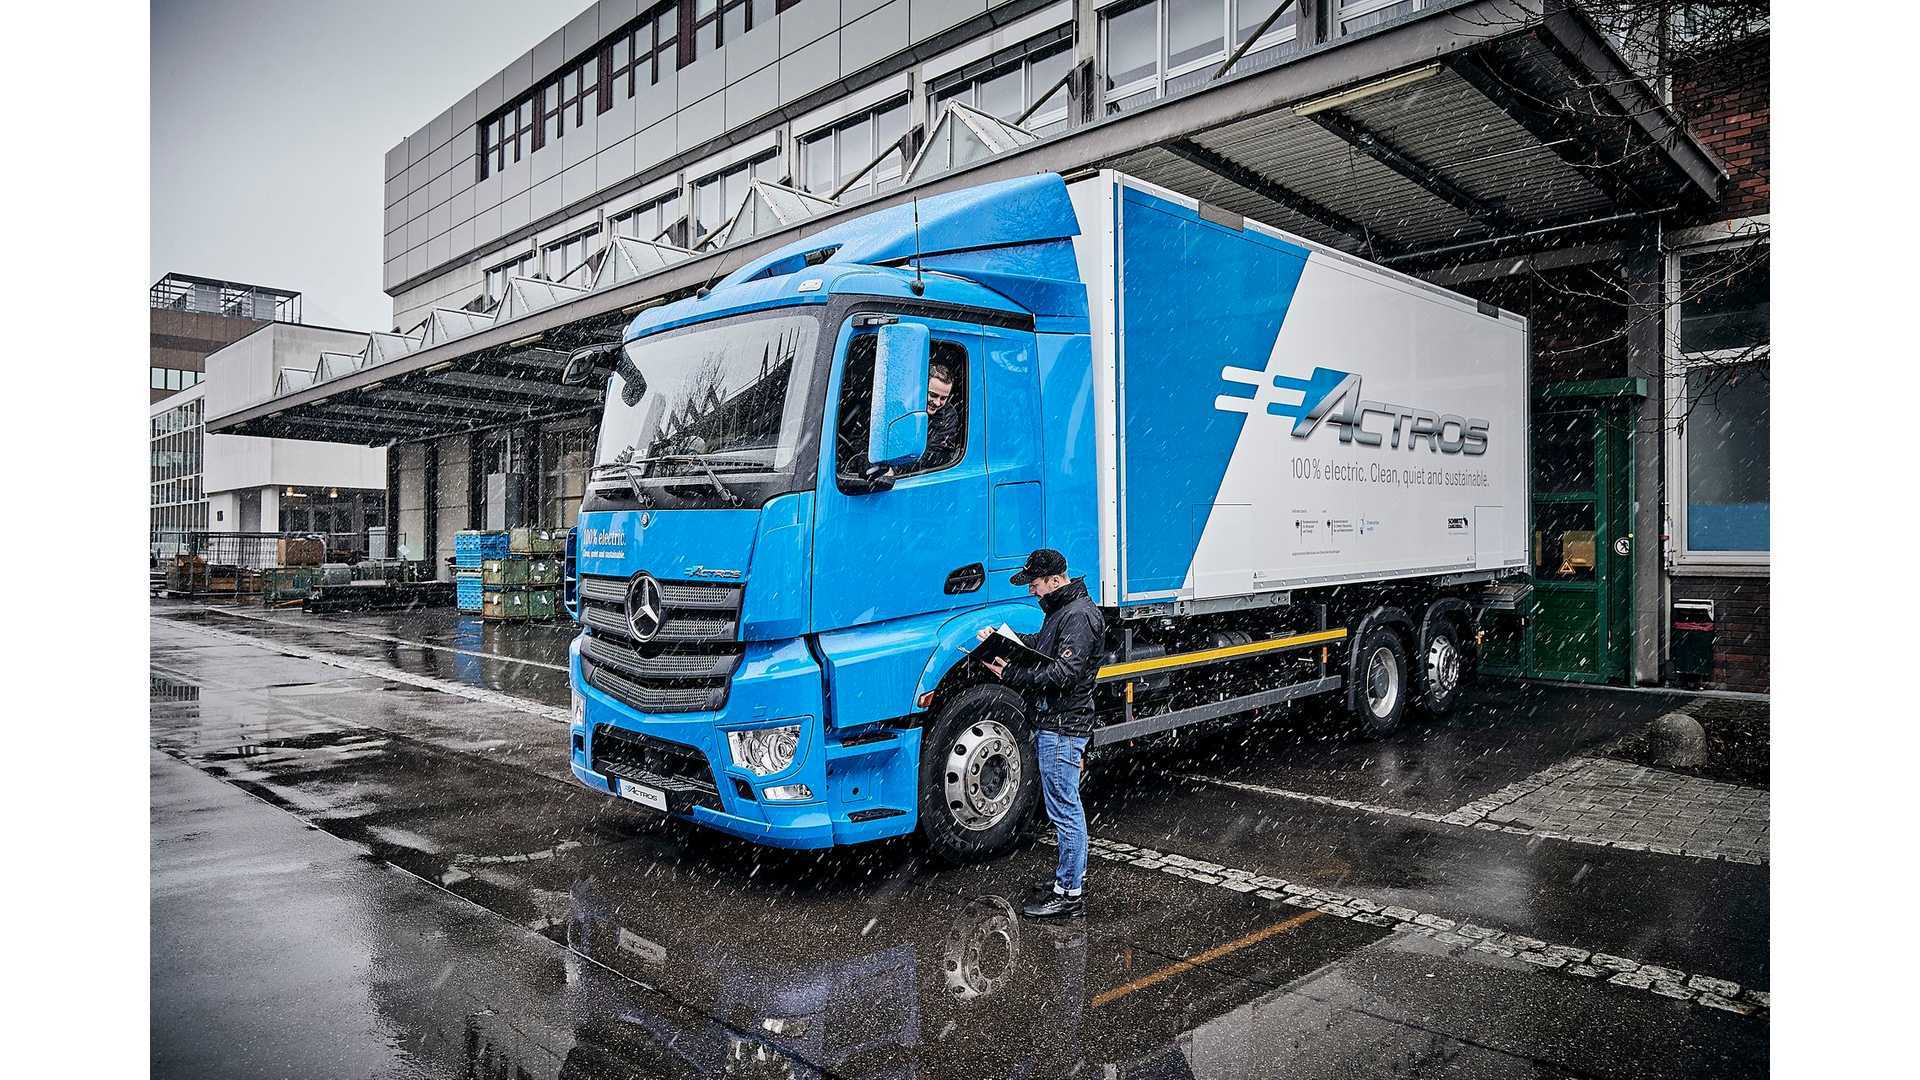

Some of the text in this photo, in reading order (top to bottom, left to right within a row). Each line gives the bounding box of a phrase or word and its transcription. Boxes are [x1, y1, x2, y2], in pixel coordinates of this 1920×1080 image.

[1291, 373, 1490, 457] ACTROS
[1291, 457, 1490, 489] 100% electric. Clean, quiet and sustainable.
[598, 529, 626, 546] electric.
[628, 786, 658, 802] ACTROS
